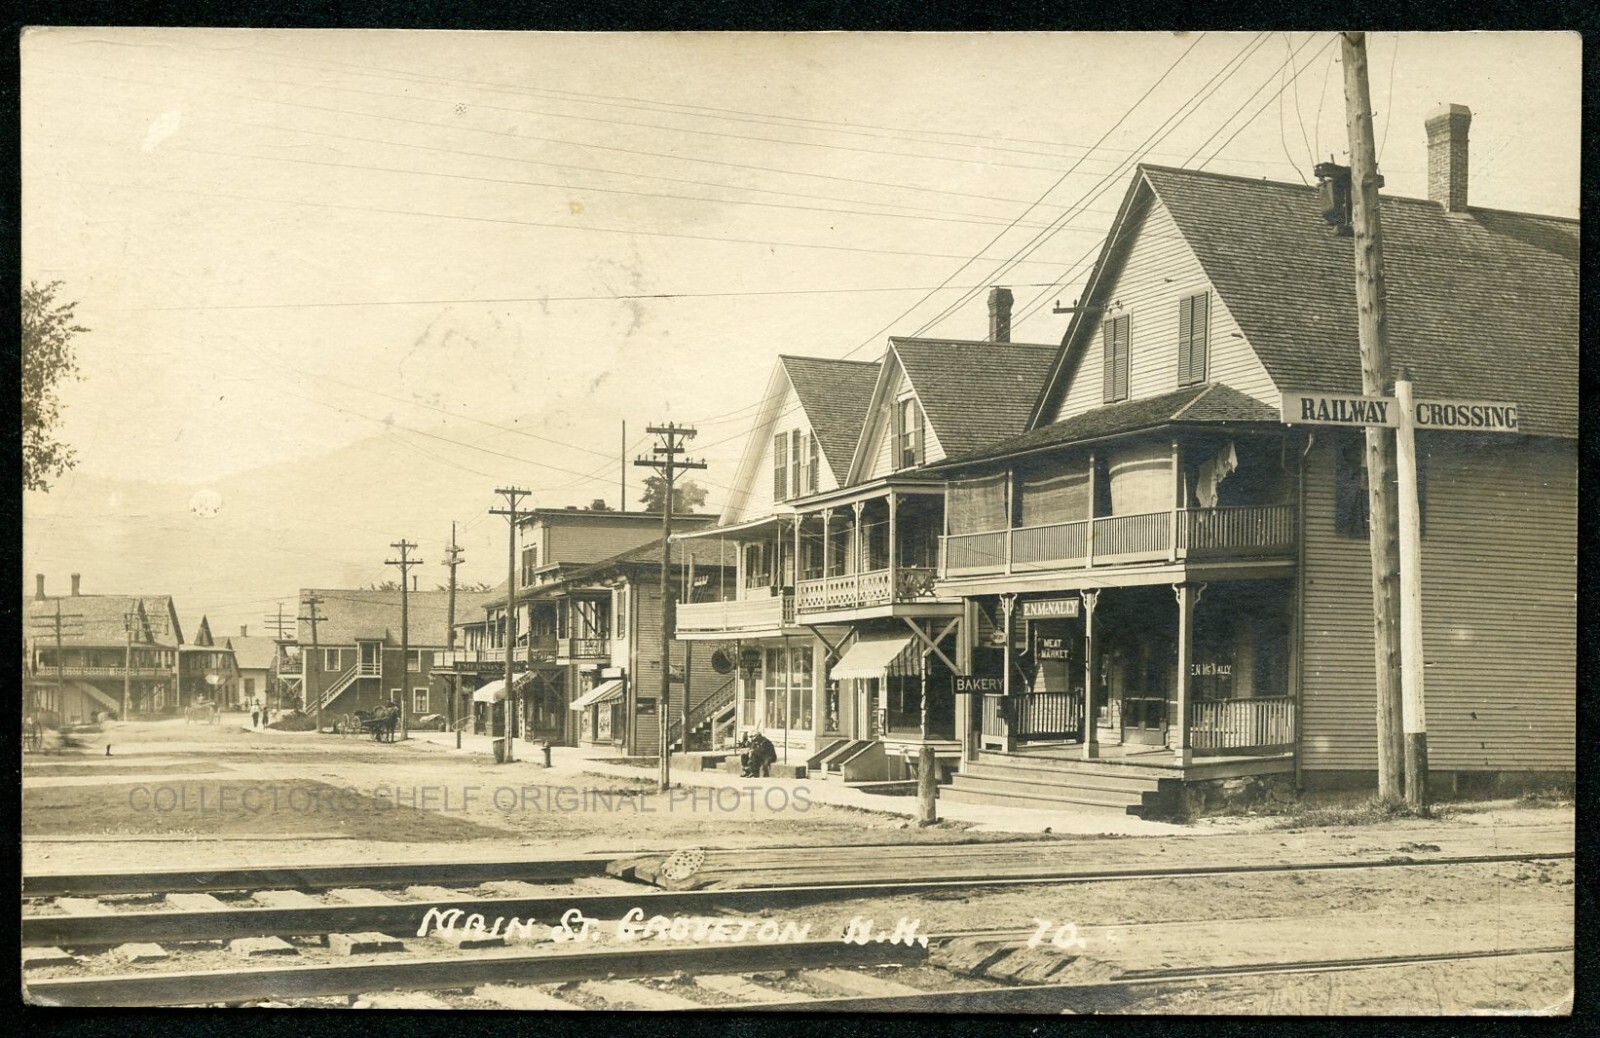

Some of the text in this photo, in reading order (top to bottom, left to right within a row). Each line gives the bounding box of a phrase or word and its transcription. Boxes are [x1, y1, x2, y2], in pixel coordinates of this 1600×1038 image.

[1300, 397, 1517, 428] RAILWAY CROSSING
[1043, 638, 1062, 648] MEAT
[1041, 649, 1068, 659] MARKET
[956, 678, 1004, 691] BAKERY
